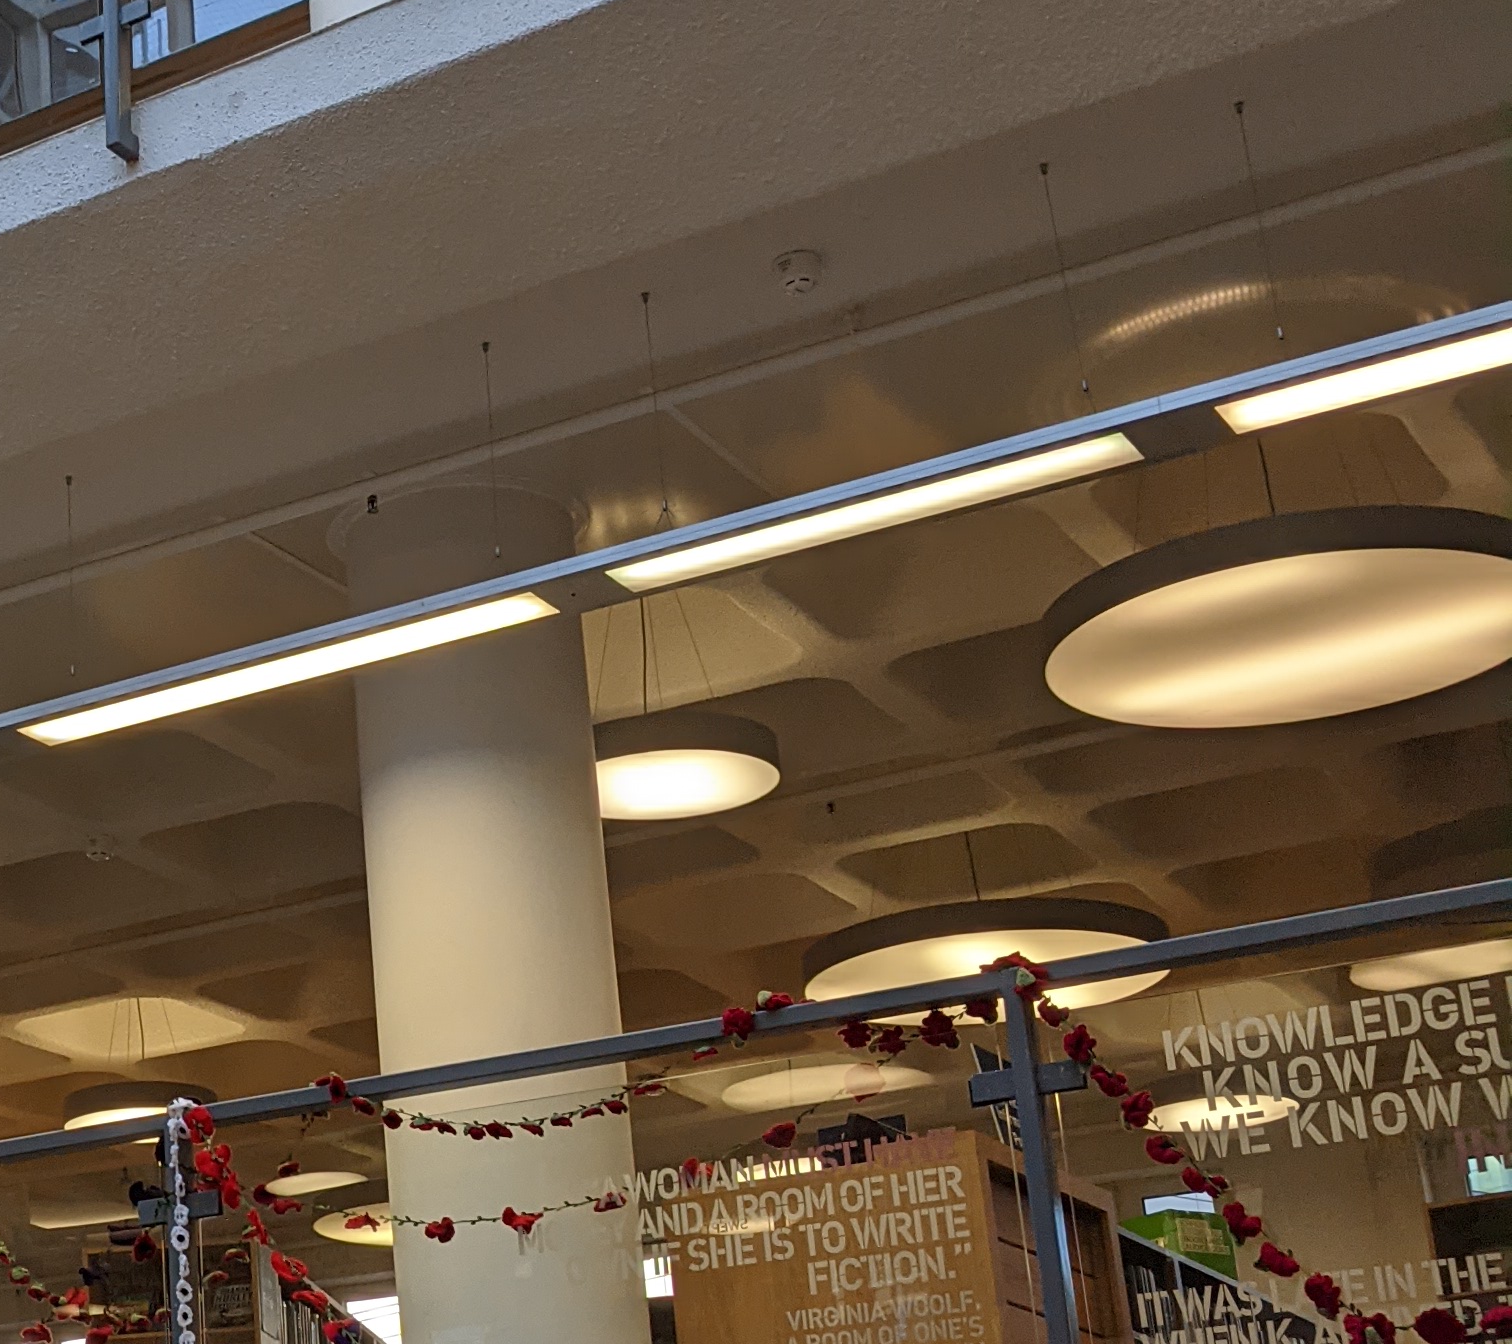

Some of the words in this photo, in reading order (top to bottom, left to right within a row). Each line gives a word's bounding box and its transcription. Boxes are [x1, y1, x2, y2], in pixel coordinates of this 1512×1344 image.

[1162, 980, 1497, 1071] KNOWLEDGE
[1202, 1045, 1377, 1111] KNOW
[1402, 1036, 1442, 1083] A
[1178, 1108, 1271, 1161] WE
[1288, 1084, 1462, 1147] KNOW
[639, 1198, 705, 1237] AND
[709, 1194, 731, 1228] A
[734, 1181, 833, 1224] ROOM
[839, 1174, 885, 1210] OF
[891, 1163, 965, 1204] HER
[785, 1299, 888, 1332] VIRGINIA
